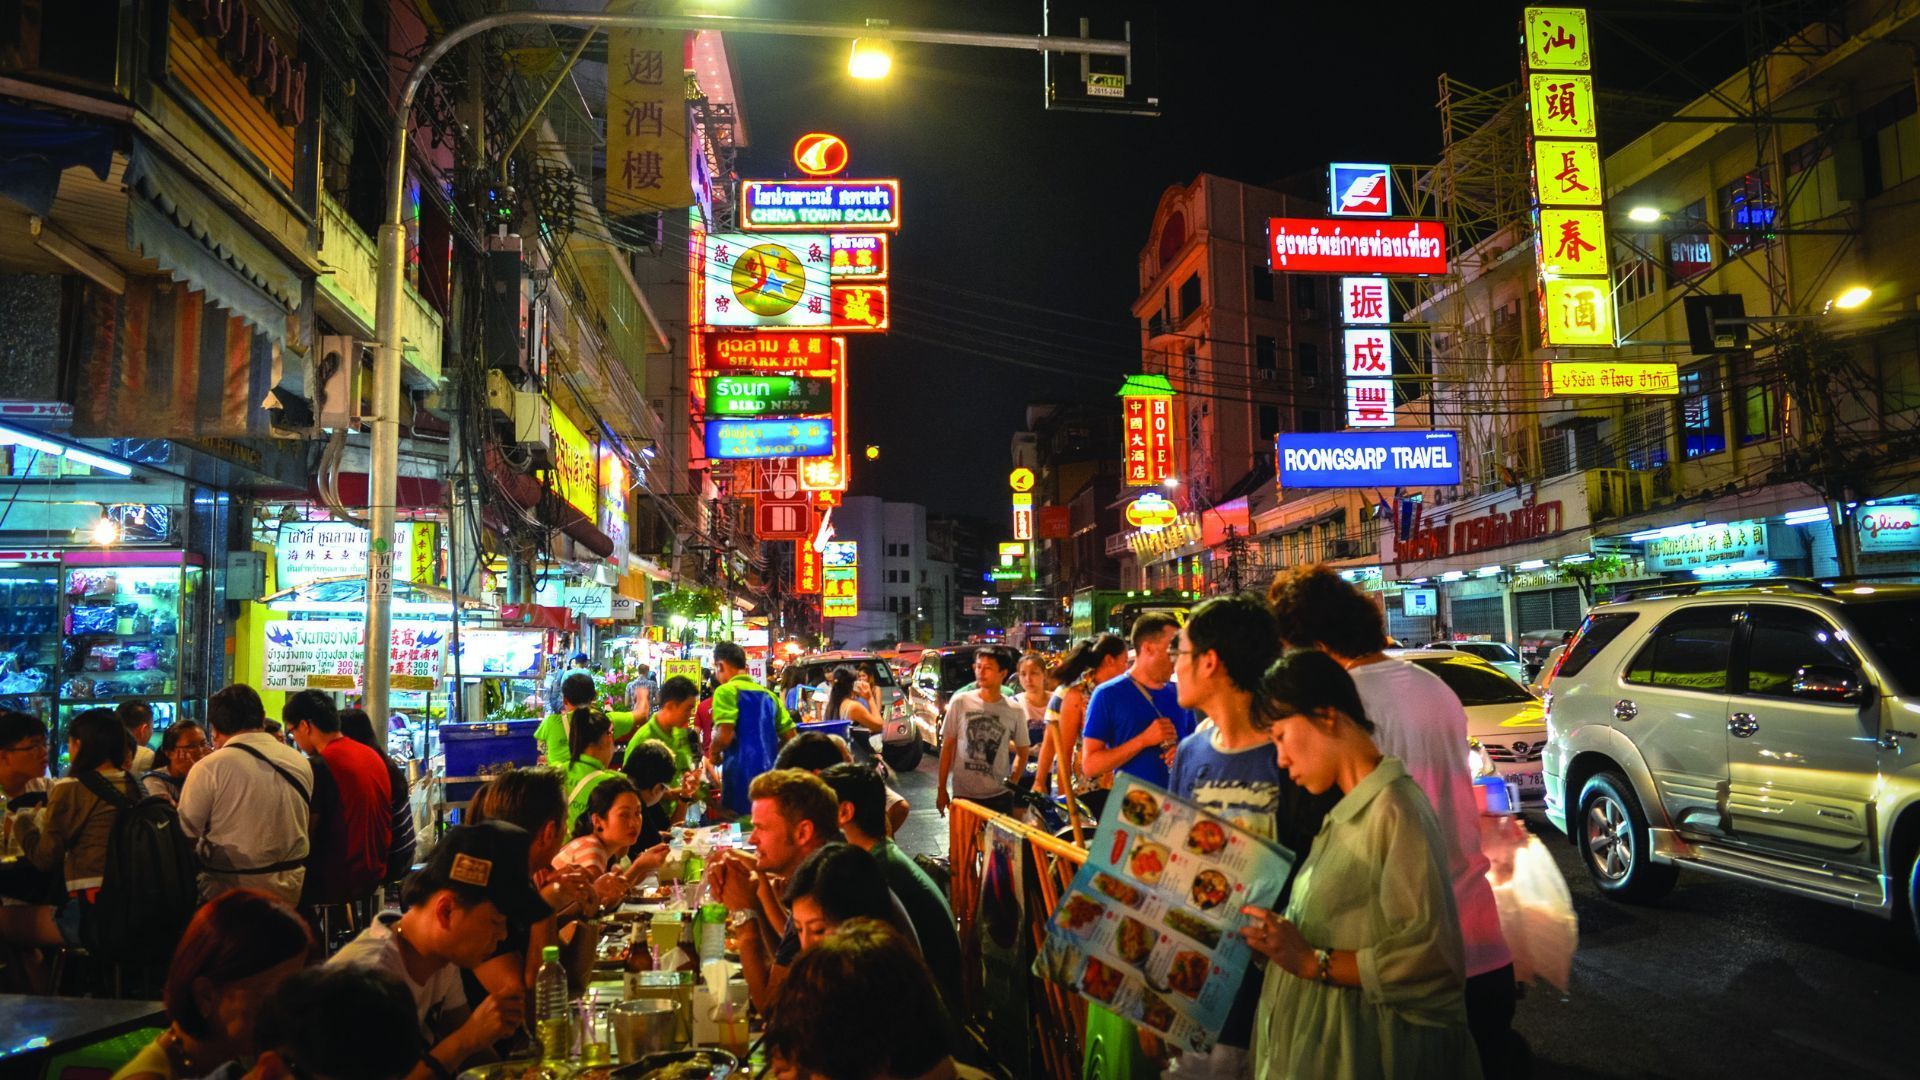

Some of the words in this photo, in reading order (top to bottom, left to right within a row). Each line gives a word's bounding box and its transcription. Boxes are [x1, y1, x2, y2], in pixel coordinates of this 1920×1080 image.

[751, 208, 796, 222] CHINA
[799, 208, 842, 222] TOWN
[845, 208, 892, 222] SCALA
[1275, 223, 1441, 266] รุ่งทรัพย์การท่องเที่ยว
[729, 356, 779, 367] SHARK
[783, 356, 808, 366] FIN
[716, 379, 770, 396] รังนก
[728, 400, 765, 411] BIRD
[771, 400, 811, 411] NEST
[1130, 401, 1146, 479] 中國大酒店
[1154, 401, 1167, 479] HOTEL
[1284, 447, 1387, 471] ROONGSARP
[1391, 446, 1452, 469] TRAVEL
[1861, 513, 1913, 539] Glico
[569, 595, 603, 605] ALBA
[338, 660, 353, 668] 300
[413, 661, 429, 669] 300
